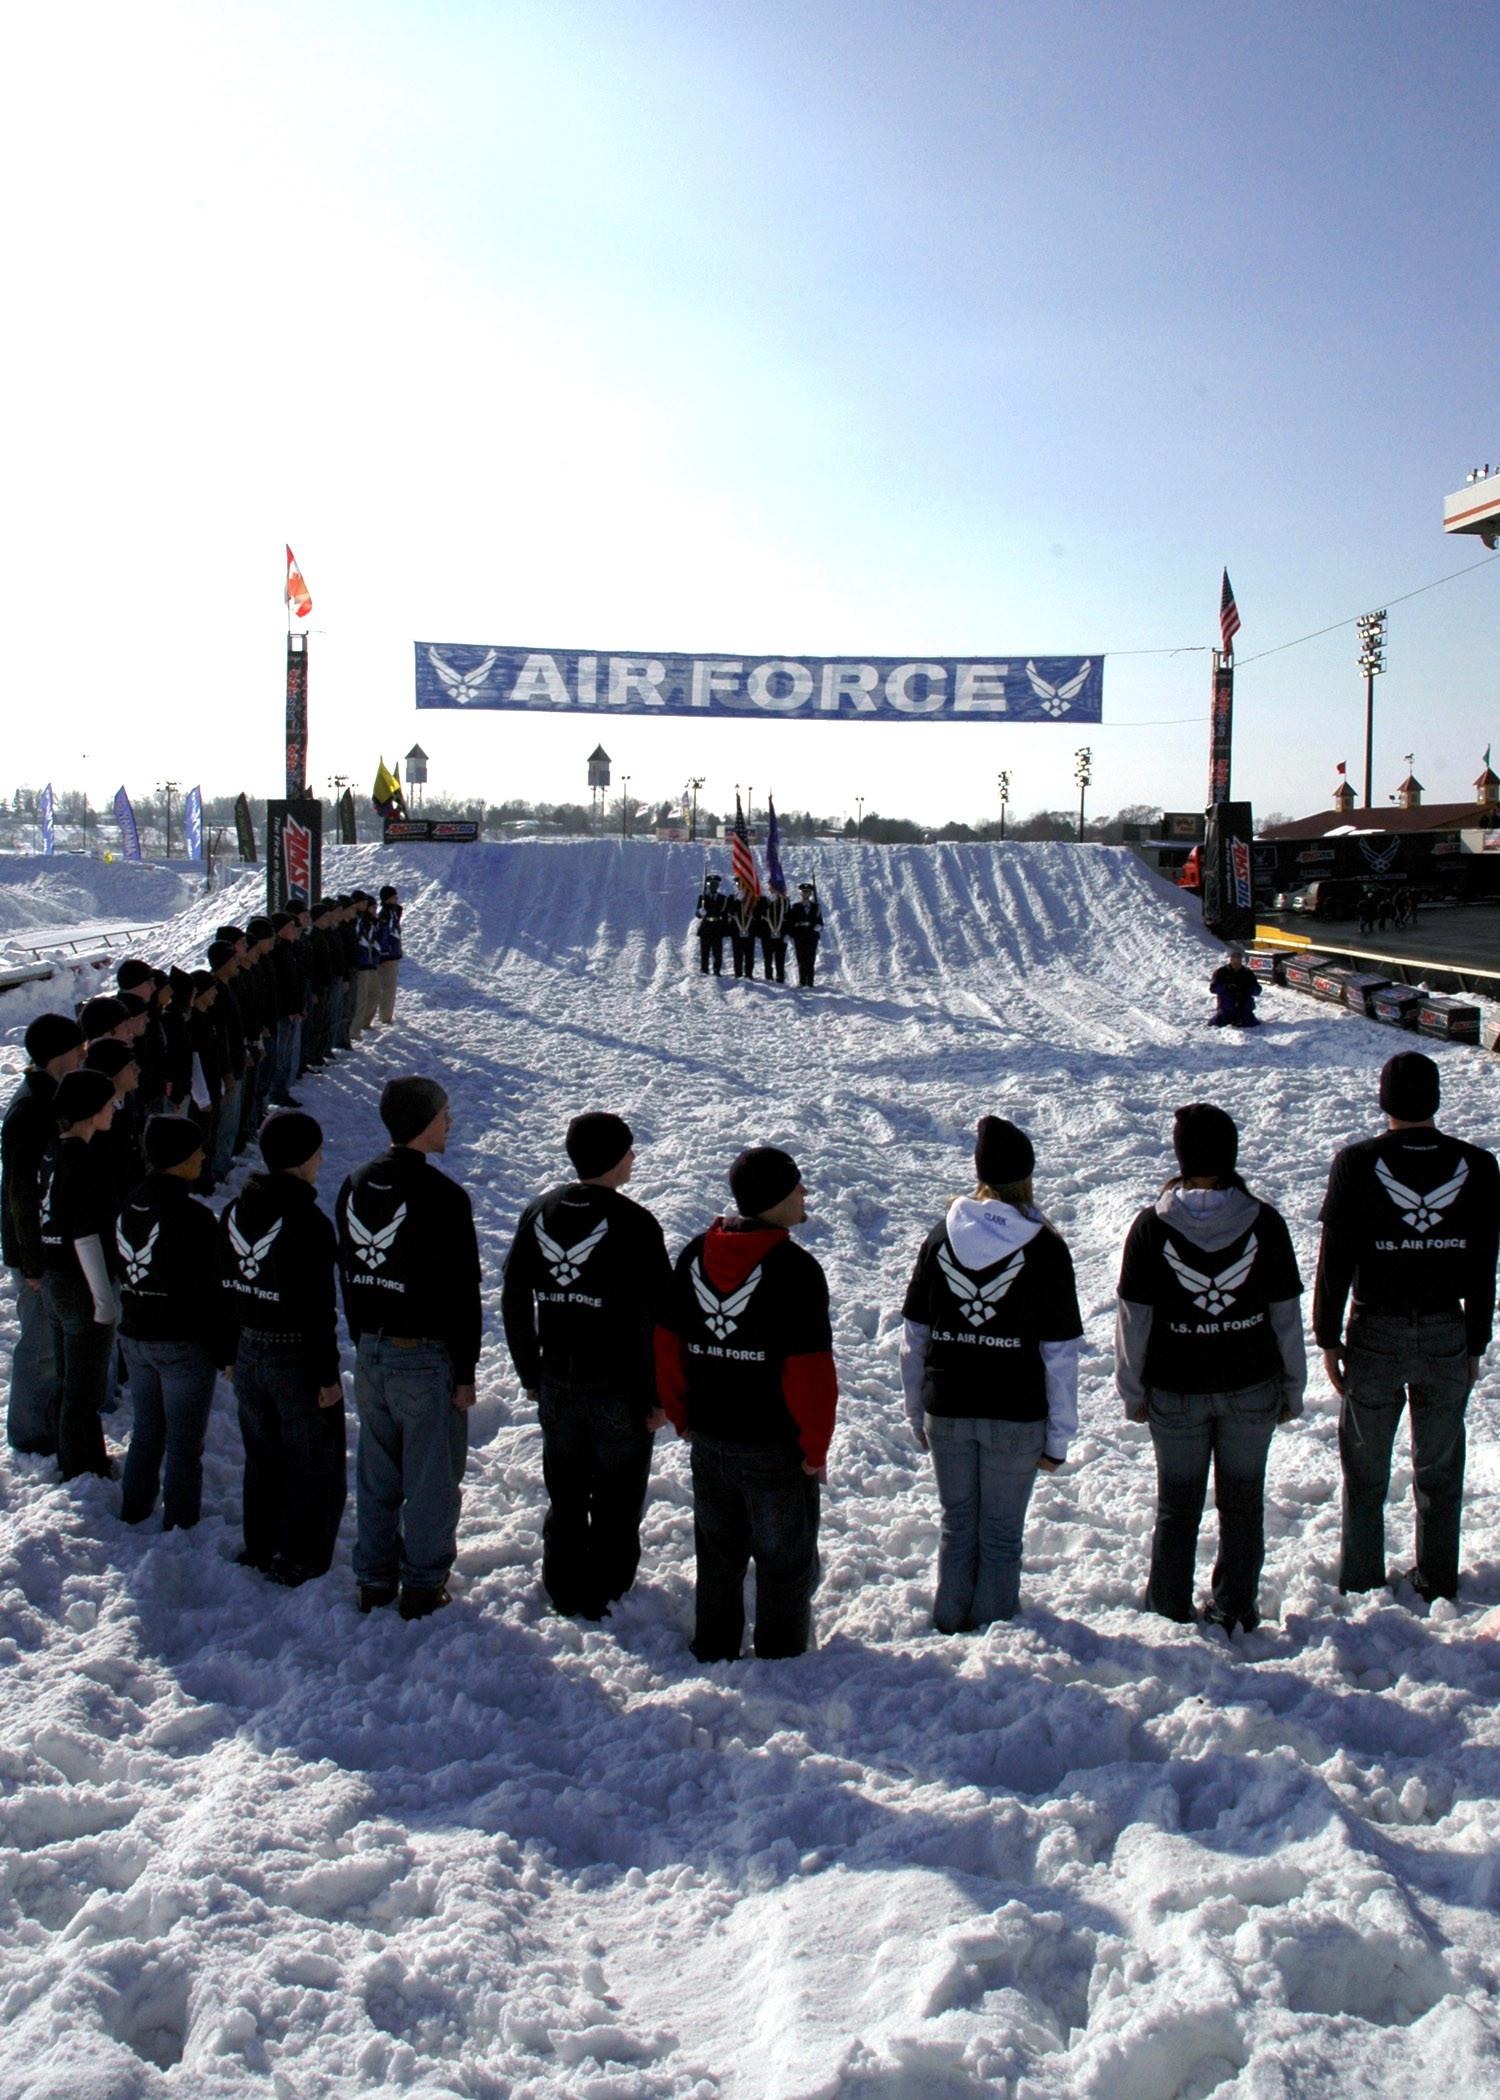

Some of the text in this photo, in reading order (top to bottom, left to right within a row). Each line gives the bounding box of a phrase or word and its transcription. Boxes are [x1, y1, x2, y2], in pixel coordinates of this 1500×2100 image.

[508, 653, 1008, 712] AIR FORCE
[273, 816, 281, 833] The
[273, 835, 281, 857] First
[284, 815, 311, 905] AMSO
[1232, 837, 1250, 907] AMSOIL
[984, 1212, 1007, 1226] CLARK
[1375, 1238, 1467, 1251] U.S. AIR FORCE
[352, 1274, 375, 1286] AIR
[376, 1276, 407, 1293] FORCE
[253, 1286, 281, 1302] FRCE
[568, 1293, 602, 1307] FORCE
[1195, 1323, 1220, 1334] AIR
[1222, 1312, 1265, 1332] FORCE
[932, 1329, 1022, 1348] U.S. AIR FORCE
[706, 1345, 724, 1357] AIR
[725, 1348, 766, 1361] FORCE
